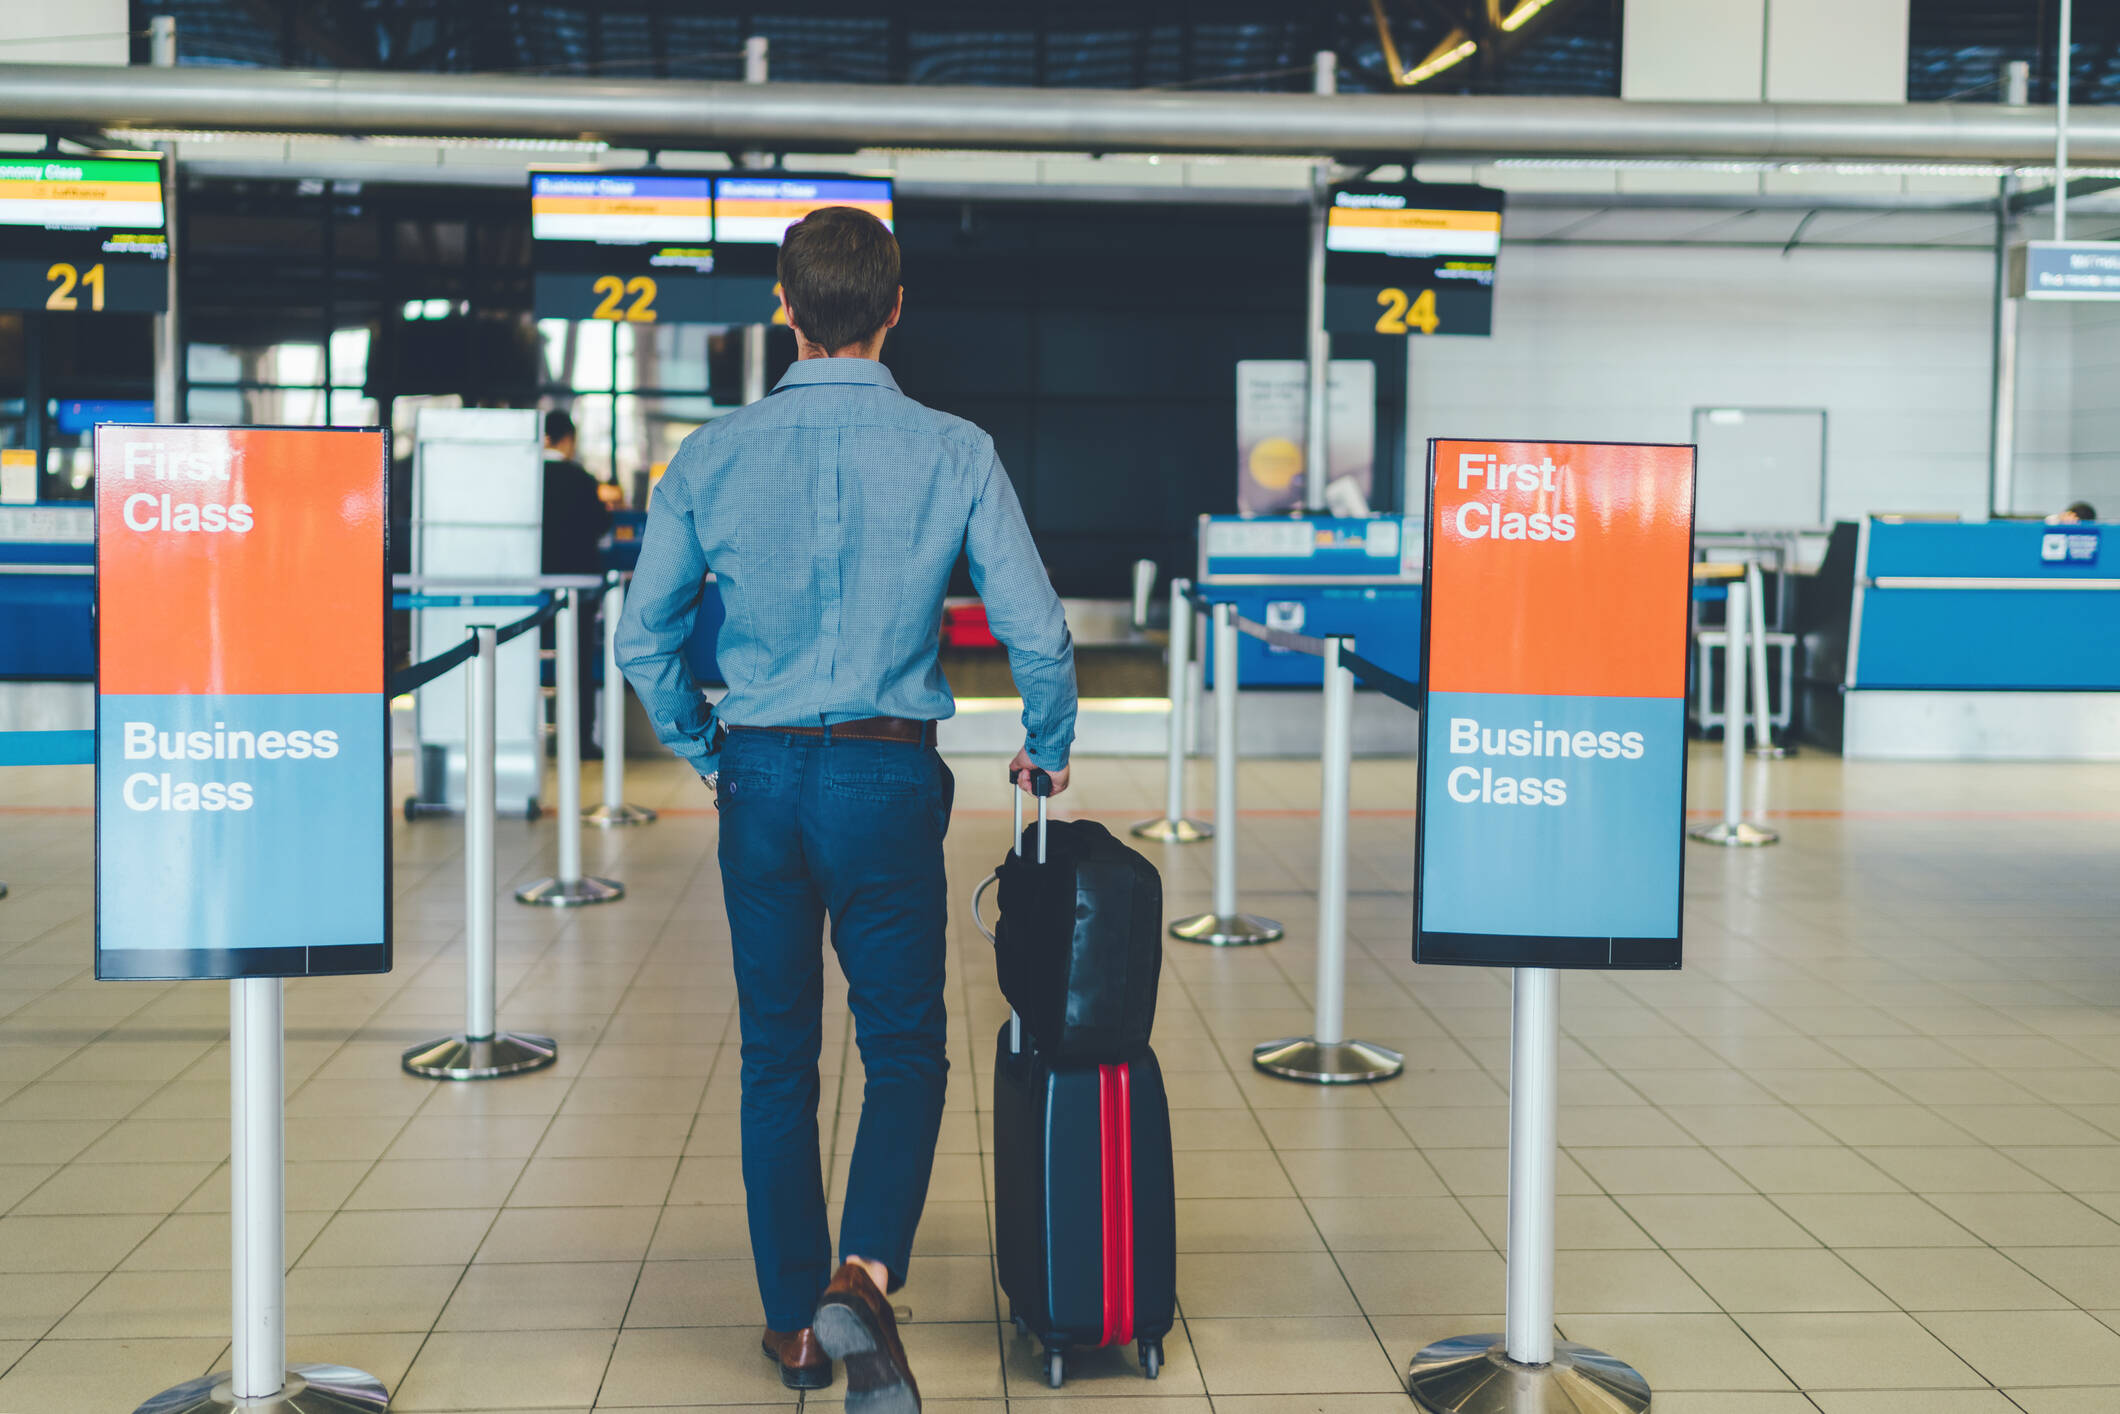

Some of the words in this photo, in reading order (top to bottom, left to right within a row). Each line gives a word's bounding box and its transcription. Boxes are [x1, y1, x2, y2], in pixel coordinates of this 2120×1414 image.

[46, 263, 105, 312] 21
[593, 275, 657, 323] 22
[1375, 287, 1440, 335] 24
[124, 442, 231, 481] First
[1458, 453, 1556, 492] First
[123, 492, 254, 533] Class
[1455, 501, 1576, 542] Class
[123, 721, 339, 760] Business
[1449, 717, 1645, 760] Business
[122, 772, 254, 812] Class
[1447, 766, 1568, 806] Class
